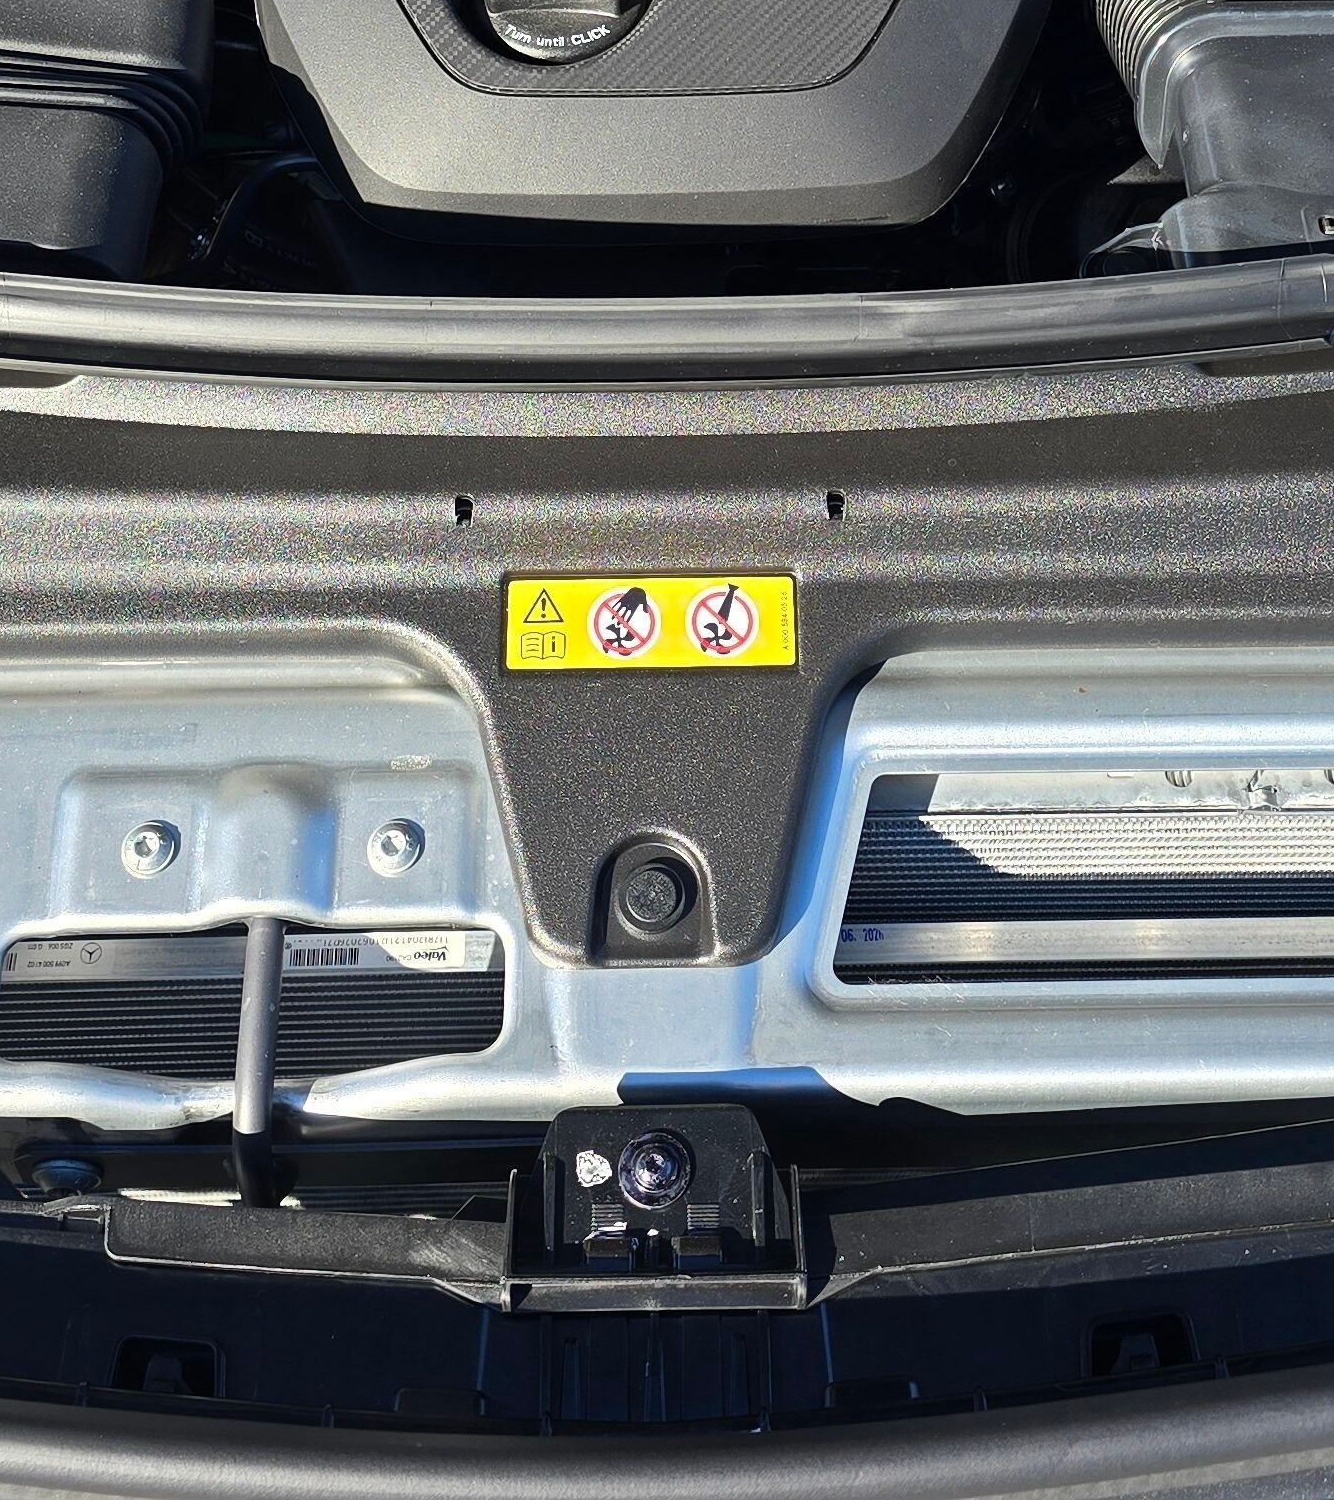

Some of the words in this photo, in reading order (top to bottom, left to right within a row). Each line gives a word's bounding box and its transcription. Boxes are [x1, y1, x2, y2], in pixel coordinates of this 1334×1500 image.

[505, 24, 532, 44] Turn
[536, 36, 565, 48] until
[570, 24, 611, 46] CLICK
[413, 951, 447, 962] Valeo
